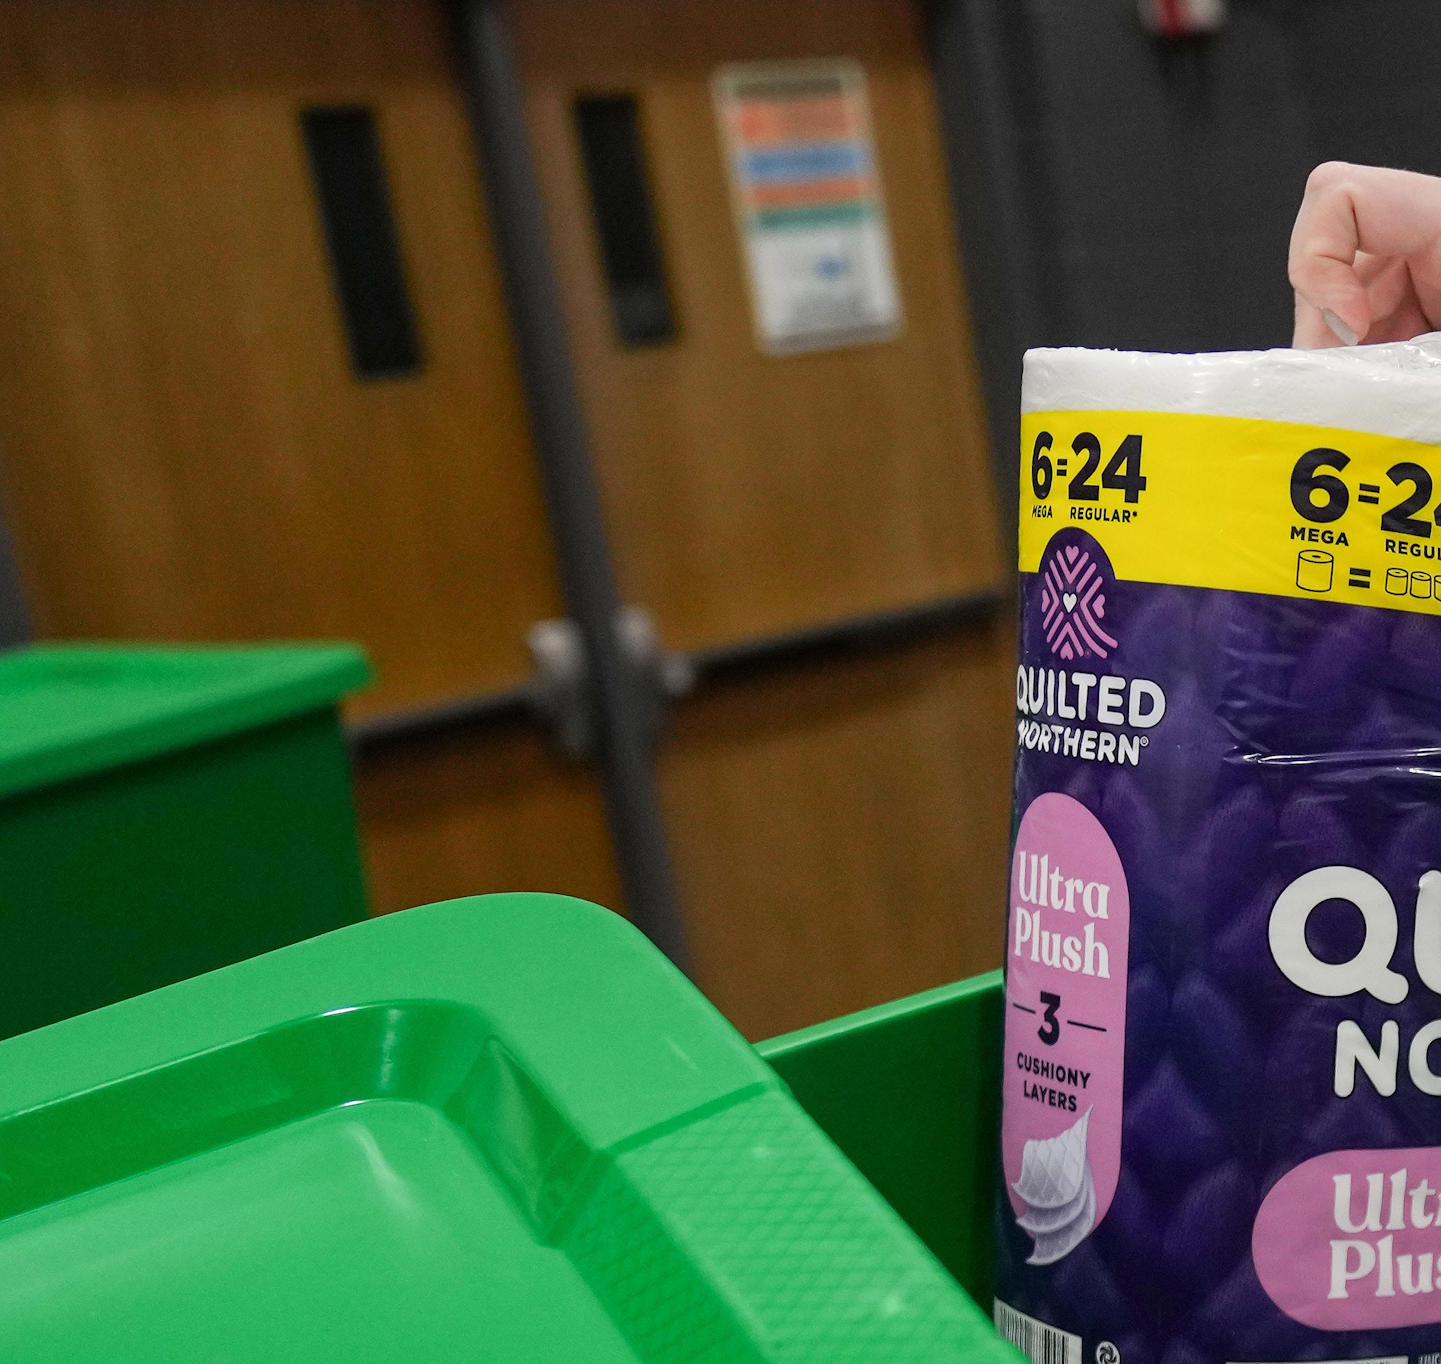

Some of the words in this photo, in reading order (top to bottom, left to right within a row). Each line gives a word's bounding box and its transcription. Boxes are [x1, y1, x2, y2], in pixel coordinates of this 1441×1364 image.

[1289, 526, 1349, 547] MEGA
[1016, 664, 1166, 728] QUILTED
[1018, 850, 1111, 920] Ultra
[1013, 906, 1111, 979] Plush
[1037, 990, 1061, 1046] 3
[1017, 1052, 1091, 1089] CUSHIONY
[1023, 1080, 1078, 1113] LAYERS
